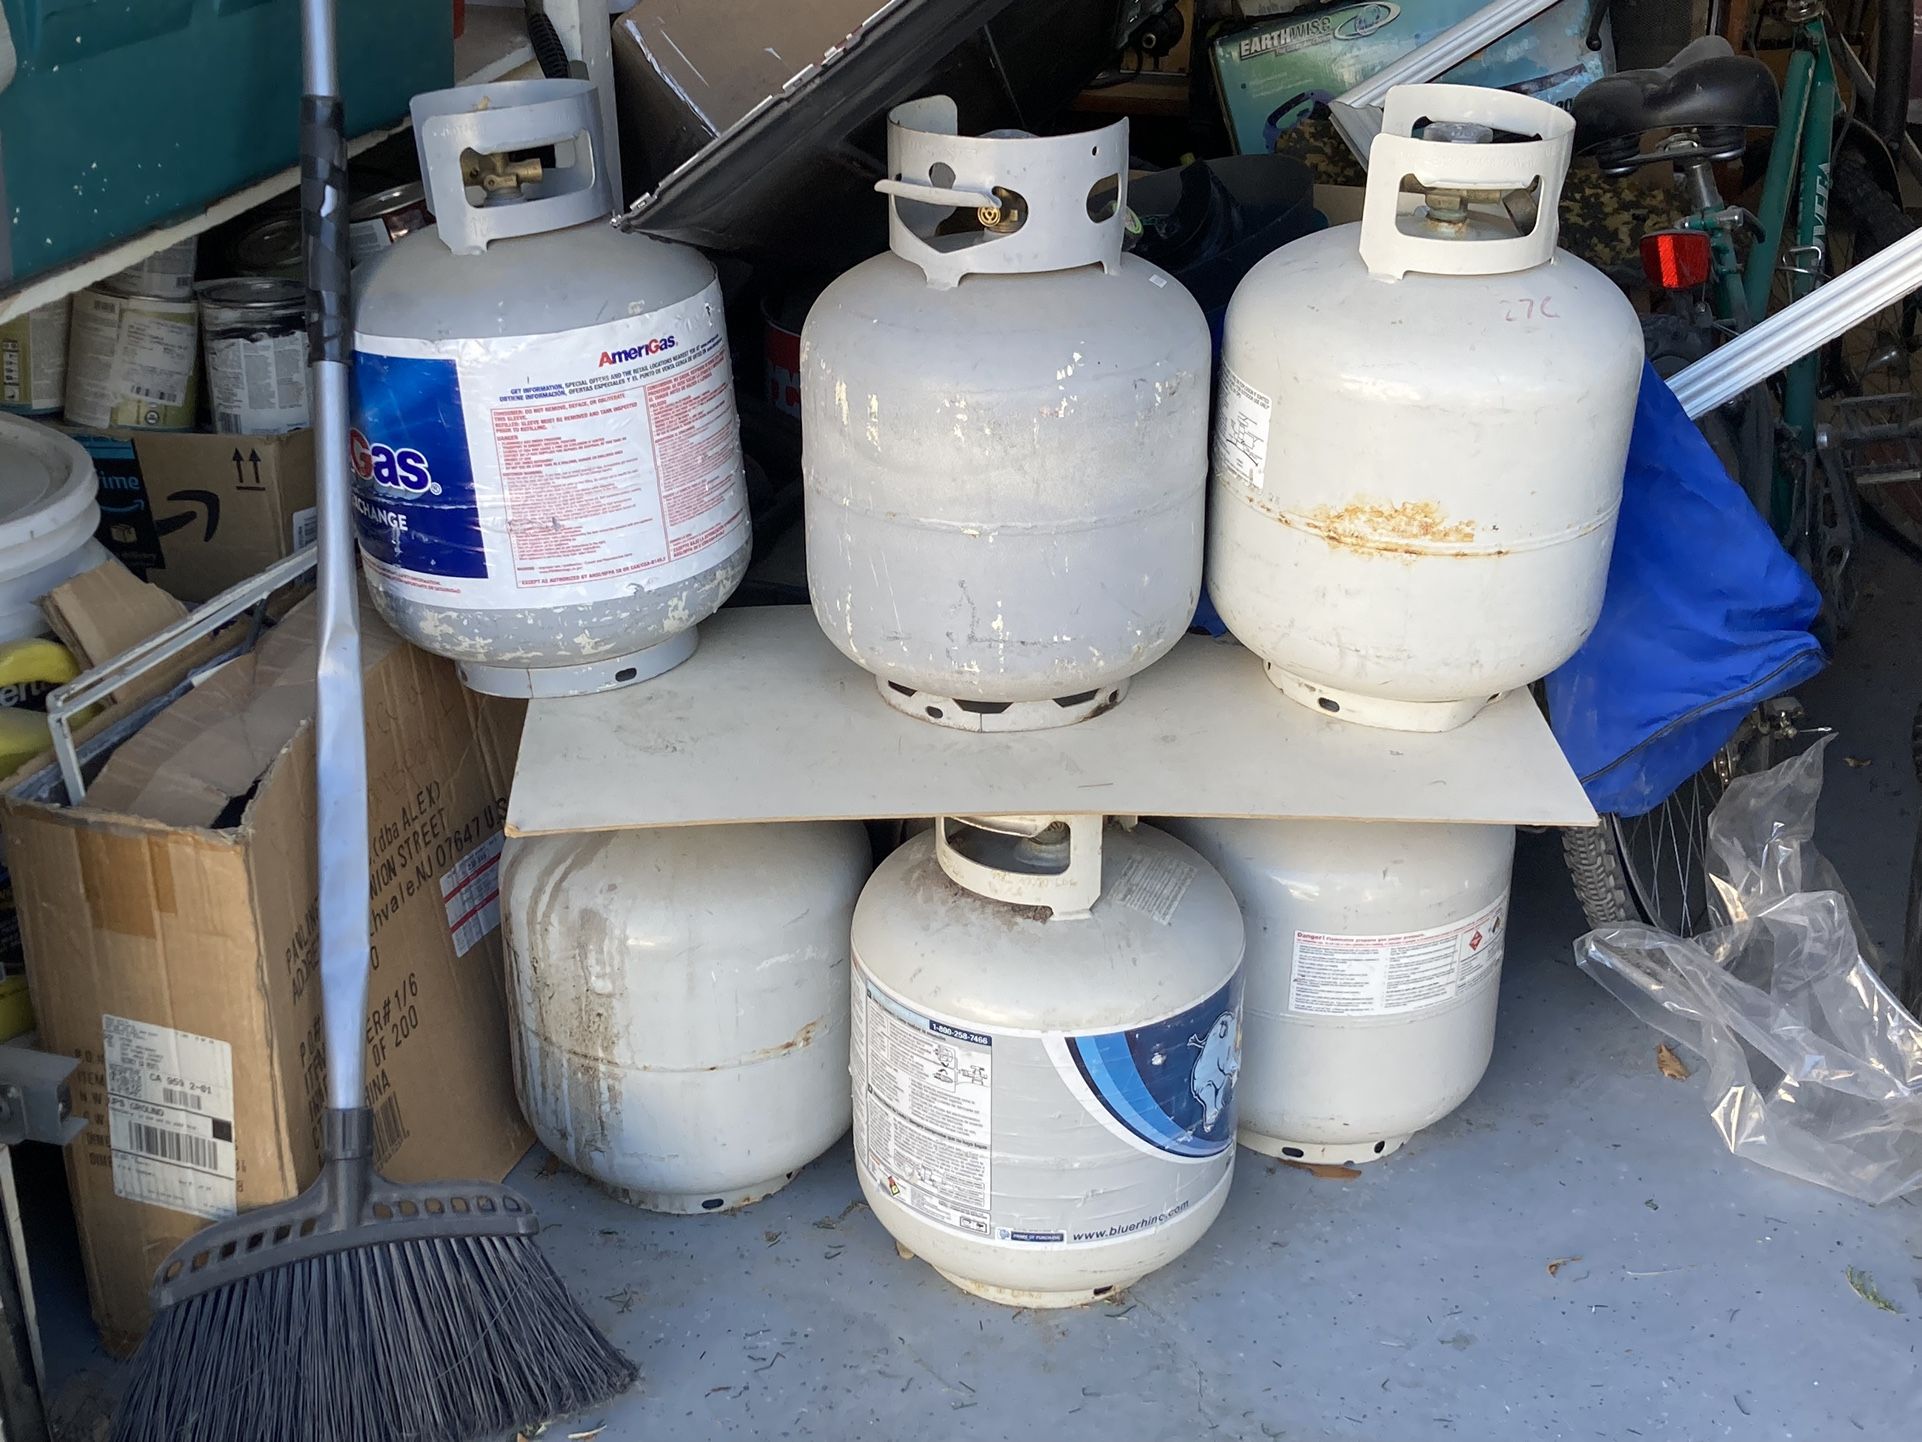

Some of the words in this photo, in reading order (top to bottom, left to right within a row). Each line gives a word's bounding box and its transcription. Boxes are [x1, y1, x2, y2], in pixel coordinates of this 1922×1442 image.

[599, 335, 677, 367] AmeriGas
[350, 428, 431, 493] Gas
[353, 495, 408, 531] XCHANGE
[401, 780, 440, 830] ALEX)
[370, 858, 397, 900] NION
[399, 808, 446, 868] STREET
[436, 816, 480, 867] 07647
[394, 972, 418, 1012] 1/6
[372, 1036, 386, 1067] OF
[392, 1005, 419, 1047] 200
